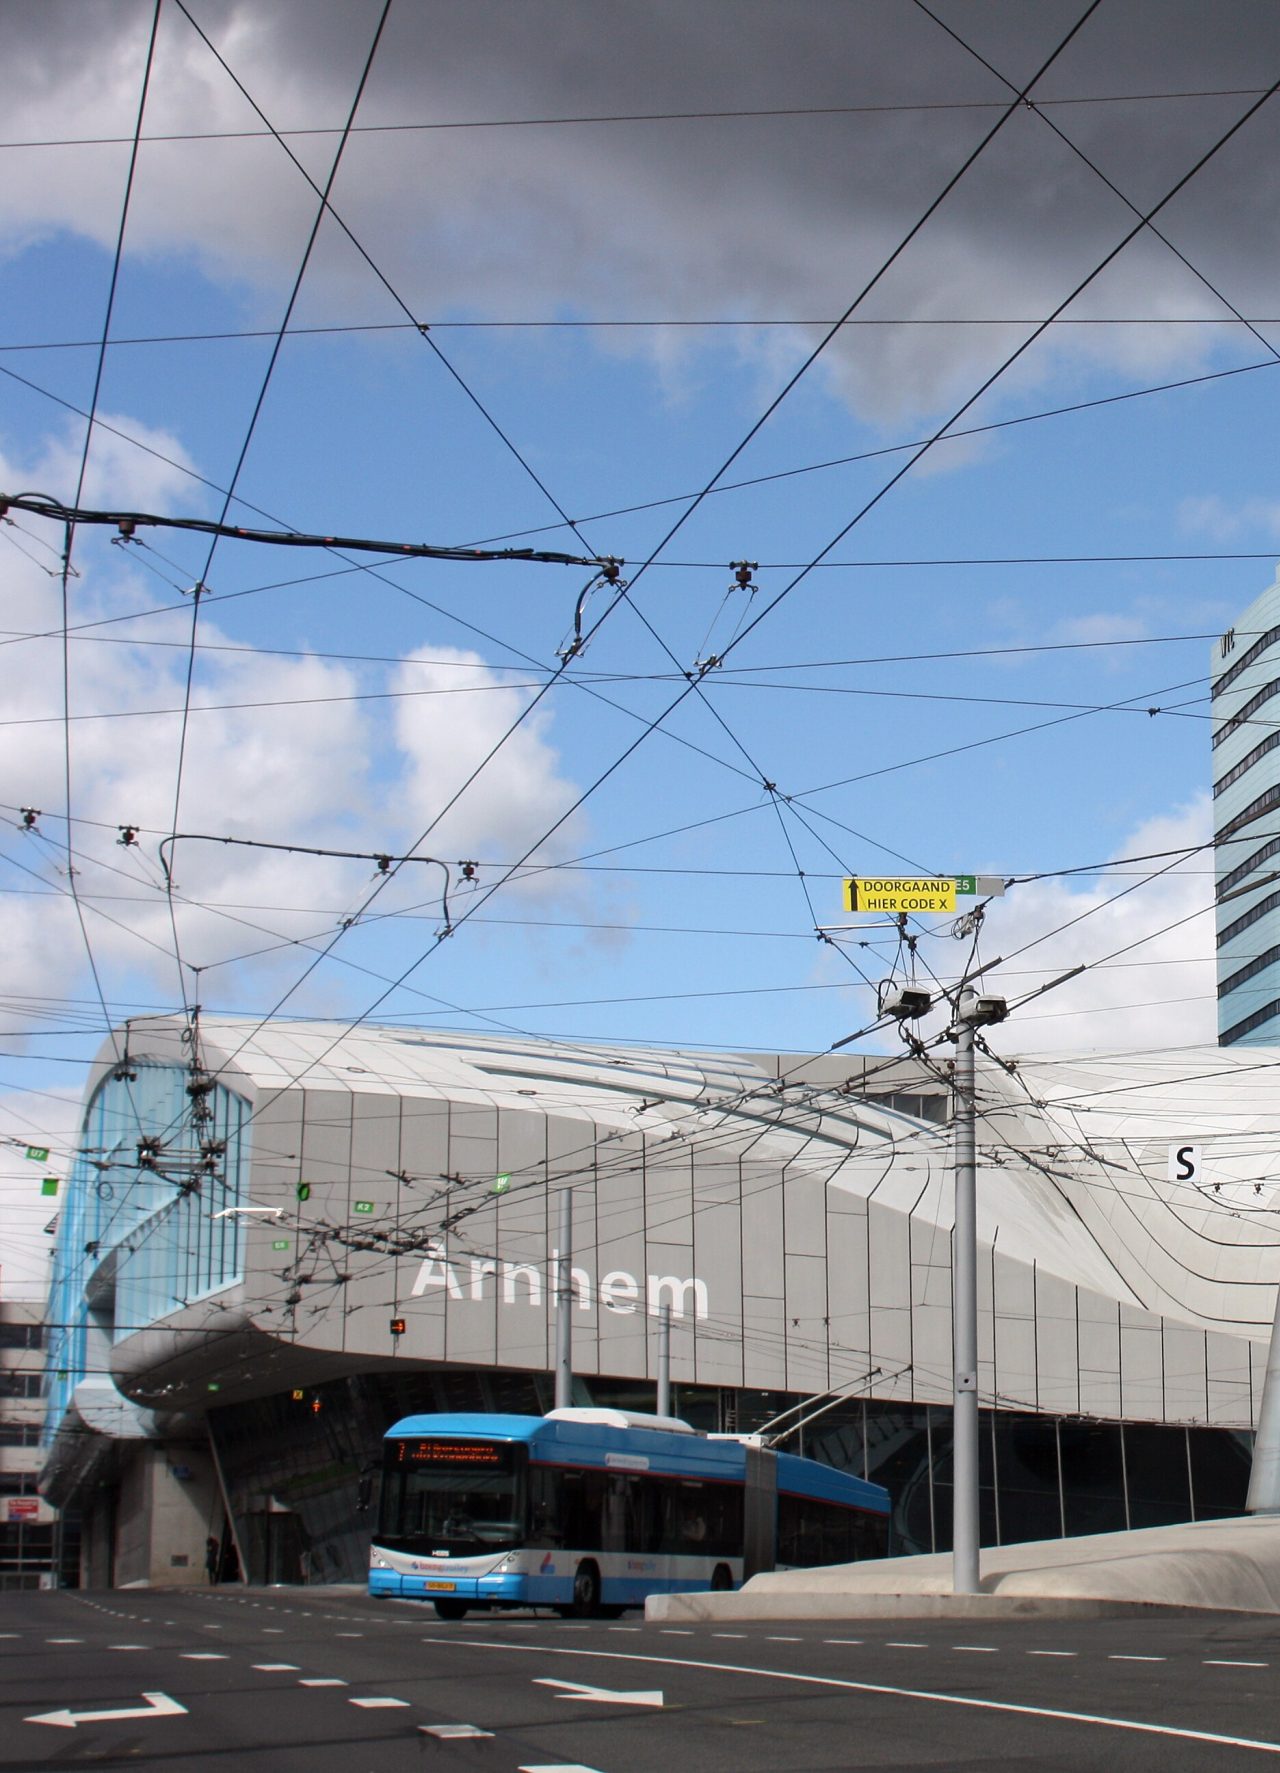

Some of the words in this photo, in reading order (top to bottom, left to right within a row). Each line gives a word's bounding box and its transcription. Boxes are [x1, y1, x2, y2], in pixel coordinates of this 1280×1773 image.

[864, 881, 950, 892] DOORGAAND
[868, 899, 897, 909] HIER
[901, 899, 935, 909] CODE
[939, 899, 947, 909] X
[1176, 1146, 1195, 1180] S
[411, 1242, 708, 1320] Arnhem
